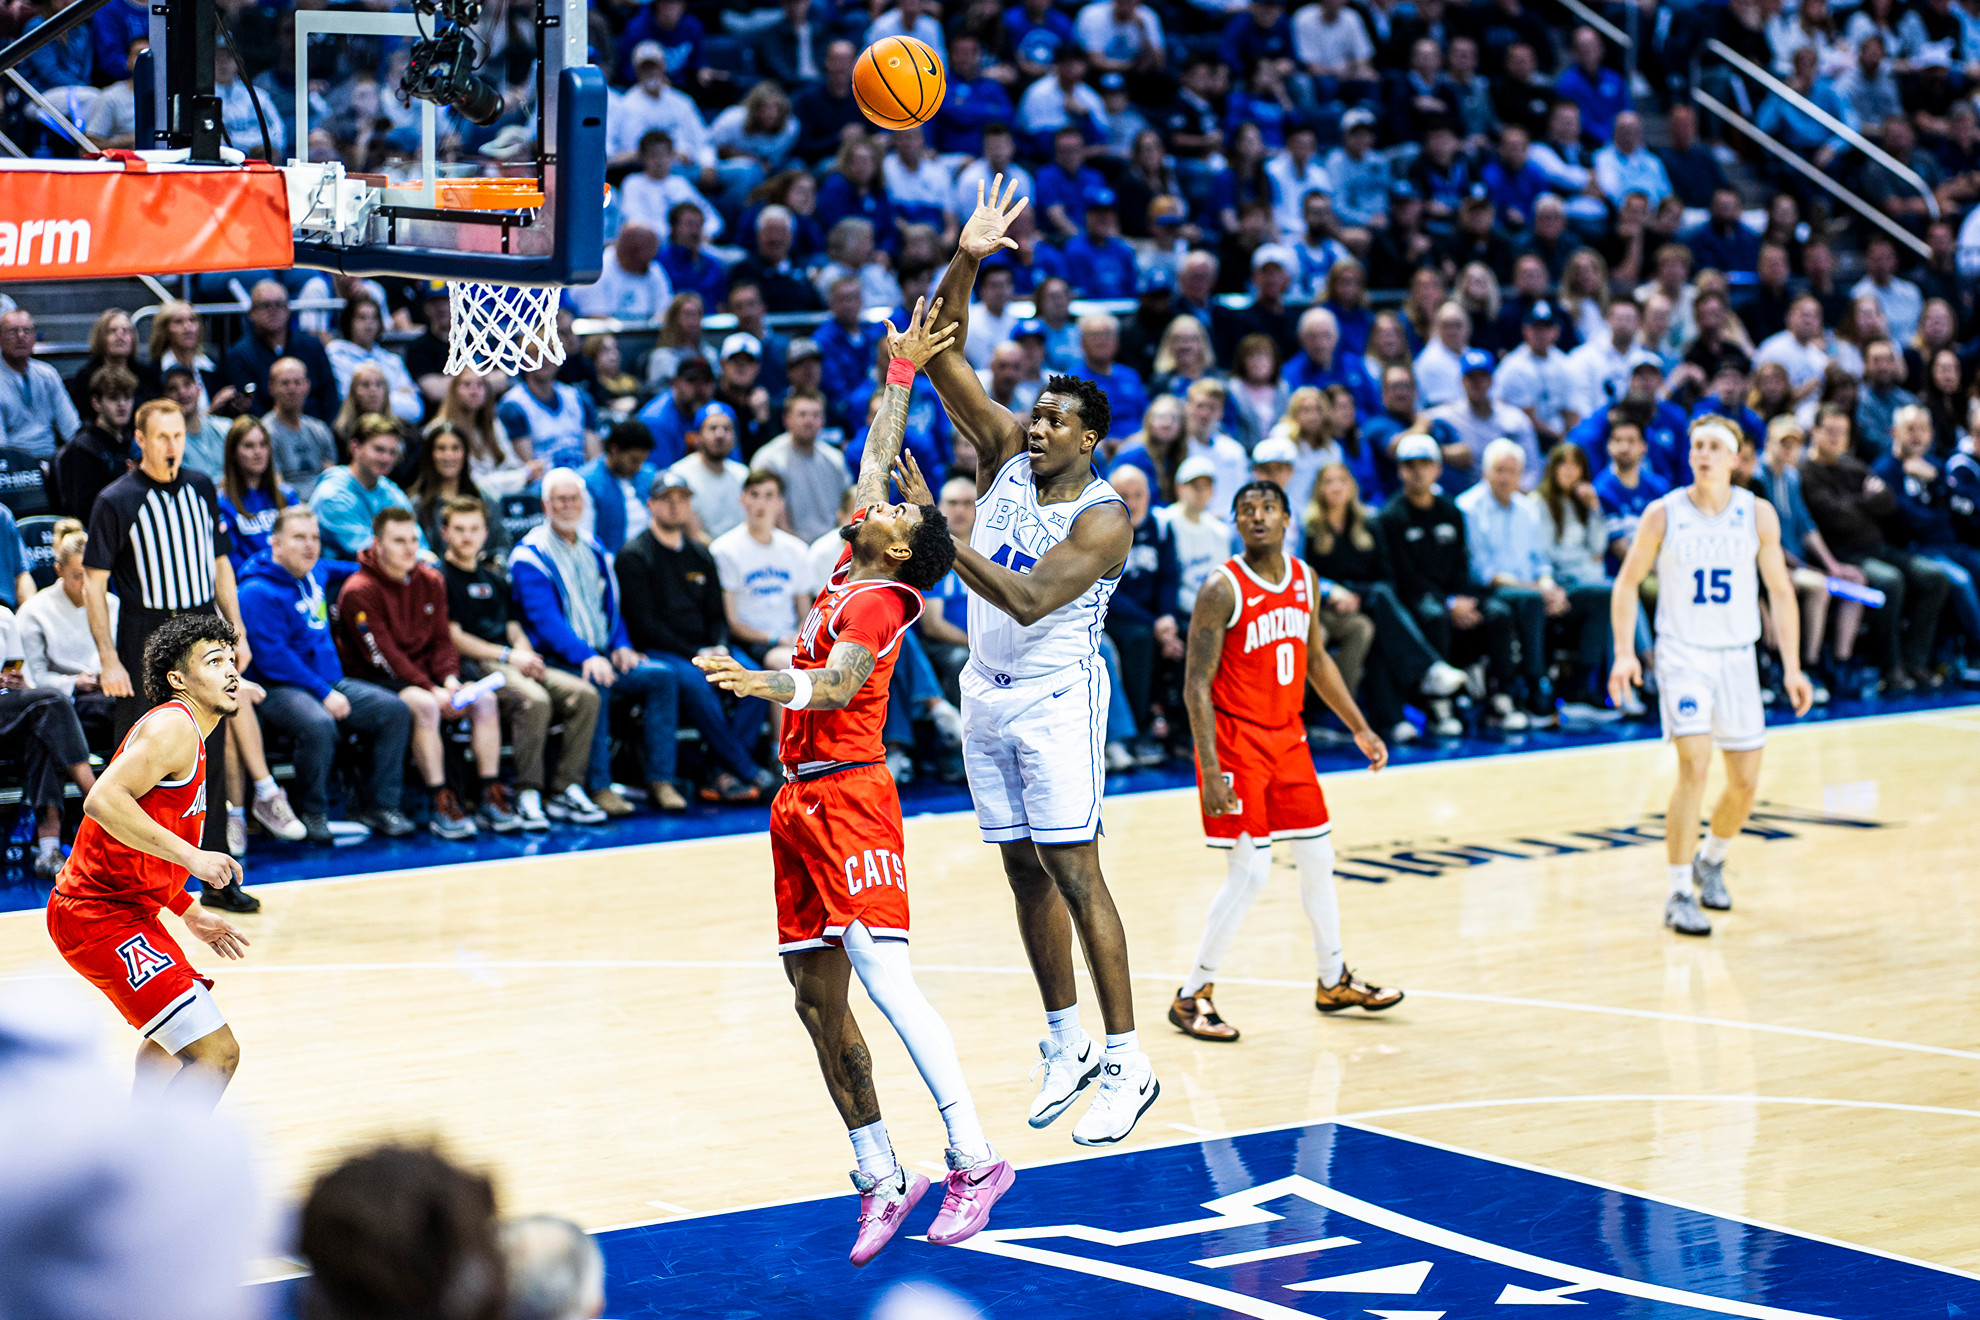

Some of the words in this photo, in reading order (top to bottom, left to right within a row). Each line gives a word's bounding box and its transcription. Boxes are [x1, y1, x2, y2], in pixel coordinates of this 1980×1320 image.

[1693, 568, 1732, 604] 15
[1243, 606, 1310, 653] ARIZON
[1276, 642, 1294, 686] 0
[844, 848, 906, 896] CATS
[115, 932, 177, 992] A
